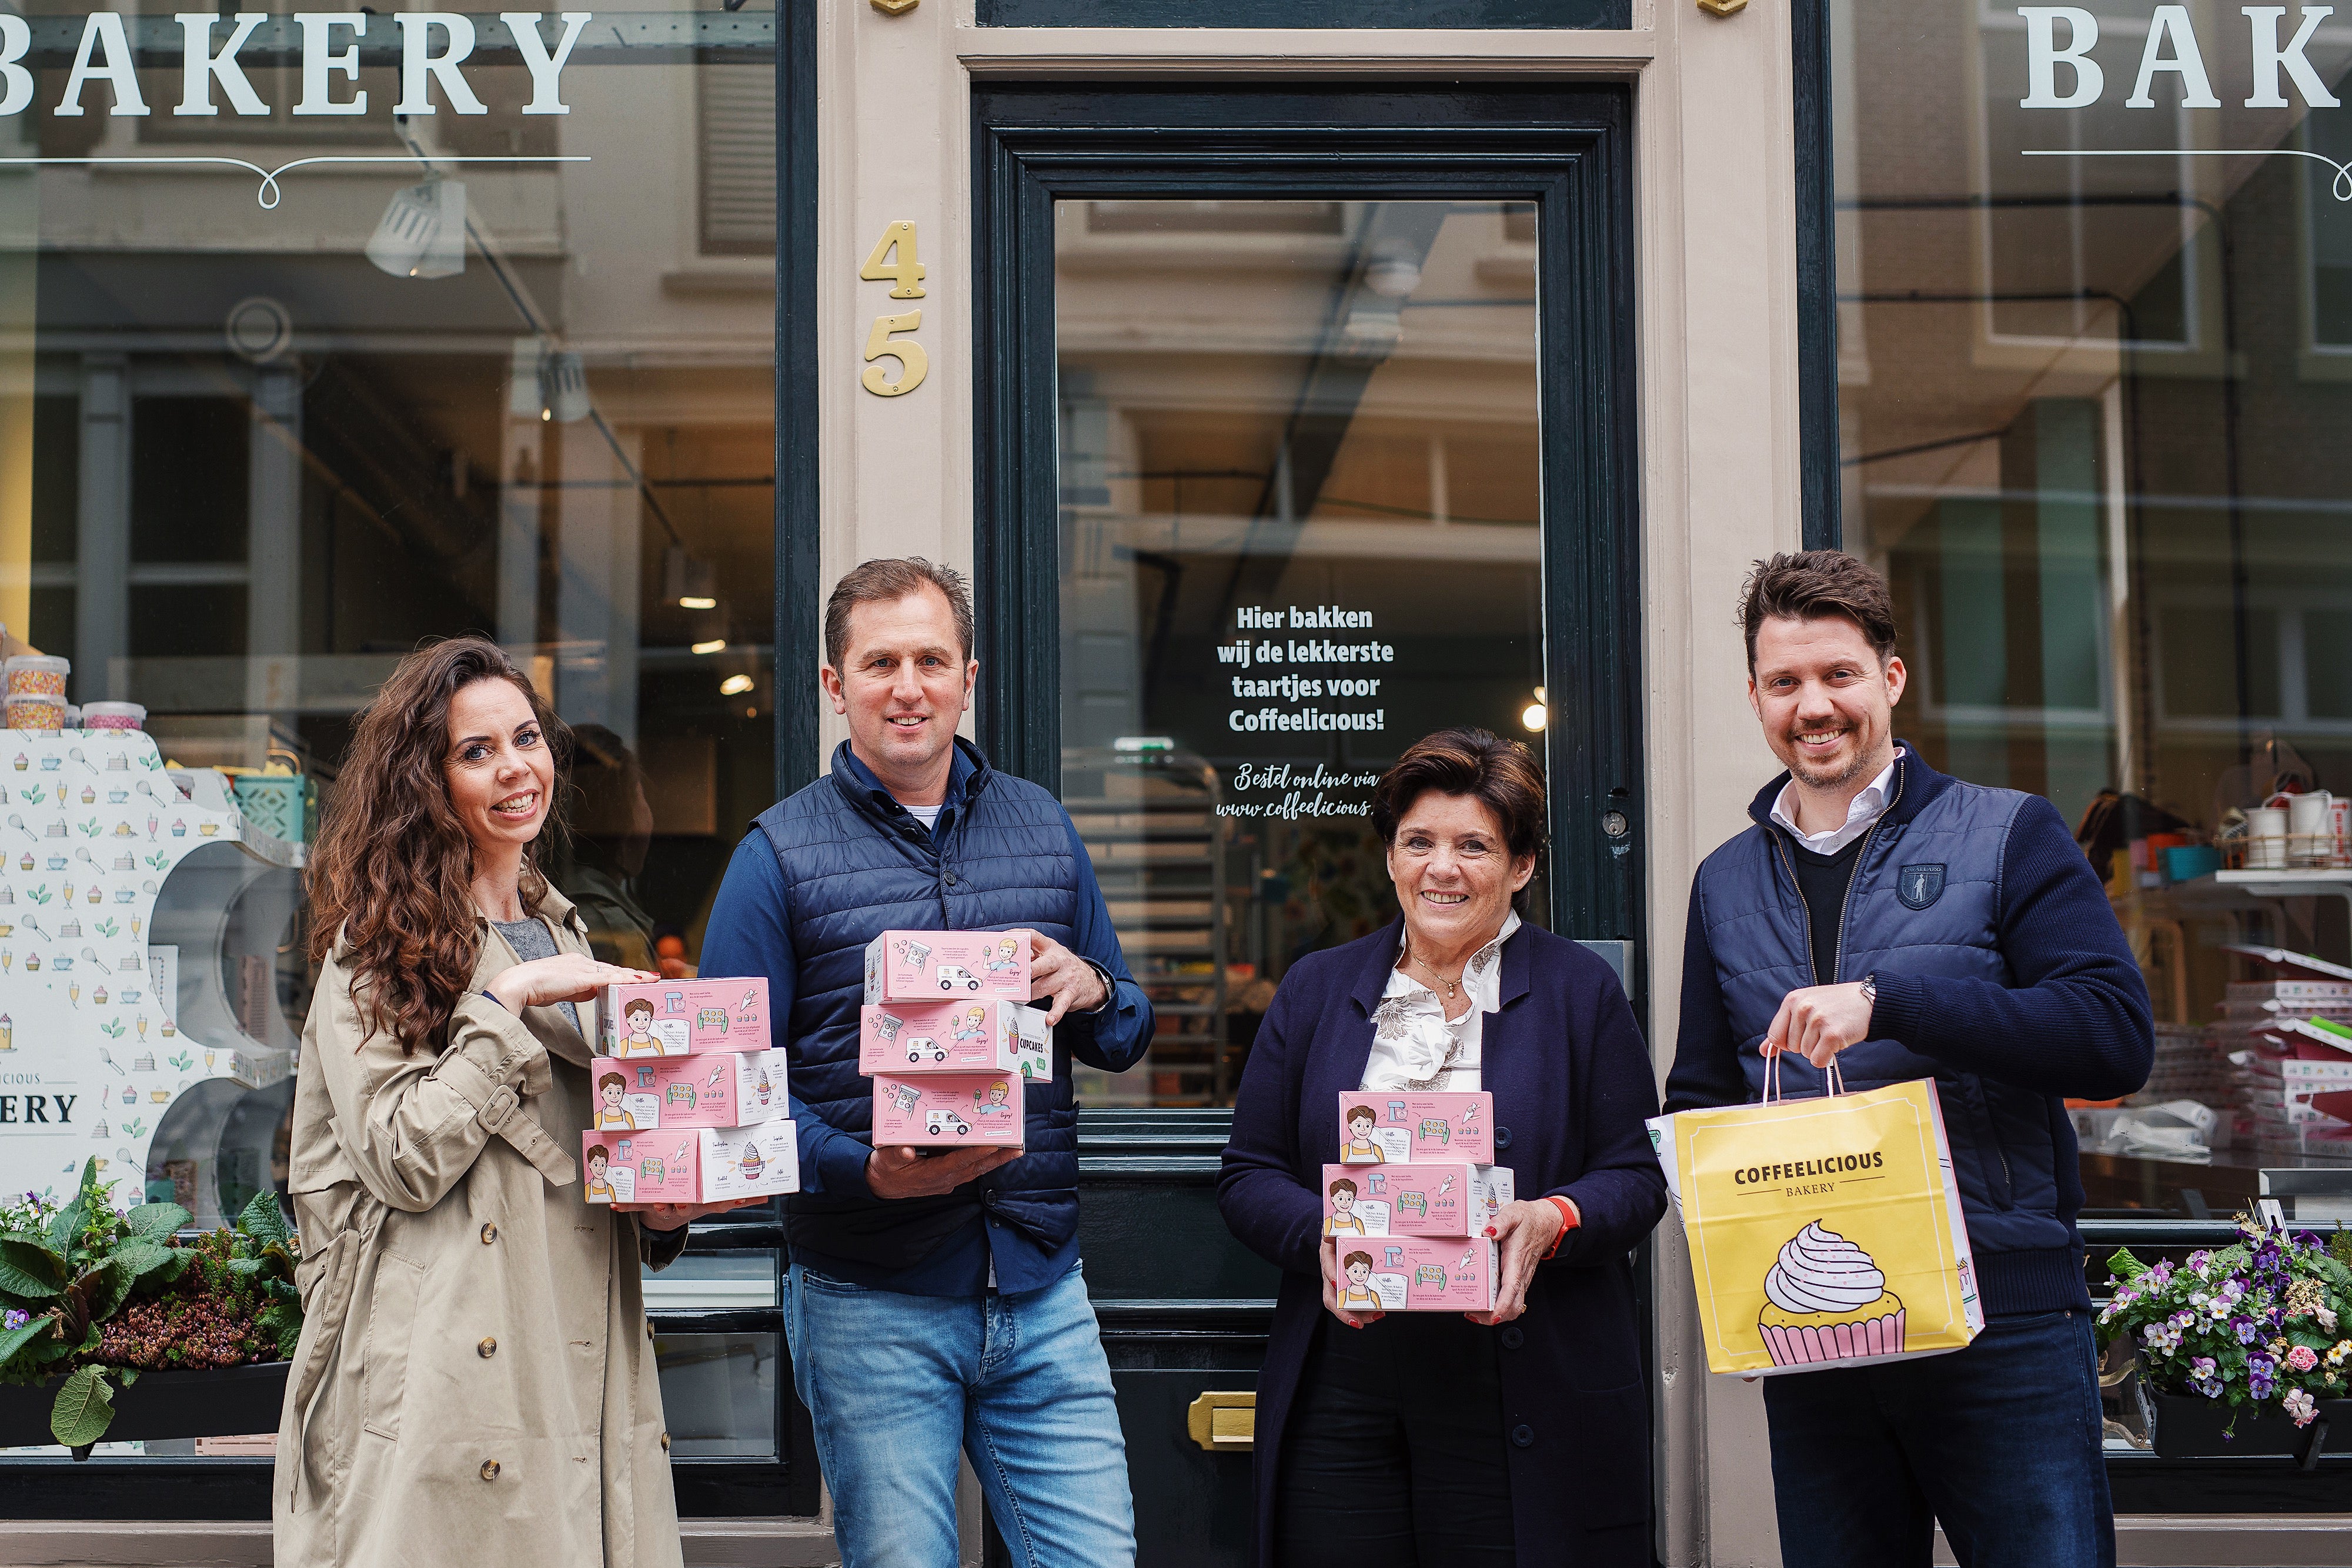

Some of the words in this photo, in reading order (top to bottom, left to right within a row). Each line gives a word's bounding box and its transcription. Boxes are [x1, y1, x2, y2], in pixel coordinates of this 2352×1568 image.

[2017, 5, 2341, 109] BAK
[1237, 606, 1285, 628] Hier
[1289, 605, 1373, 628] bakken
[1217, 640, 1251, 668] wij
[1255, 640, 1283, 663] de
[1288, 640, 1395, 663] lekkerste
[1232, 674, 1322, 702] taartjes
[1326, 678, 1381, 697] voor
[1229, 708, 1385, 731] Coffeelicious!
[1234, 763, 1291, 791] Bestel
[1292, 763, 1352, 789] online
[1353, 771, 1381, 788] via
[1009, 968, 1021, 977] Enjoy!
[1020, 1038, 1043, 1054] CUPCAKES
[0, 1094, 78, 1124] ERY
[1734, 1151, 1883, 1185] COFFEELICIOUS
[1785, 1182, 1836, 1198] BAKERY
